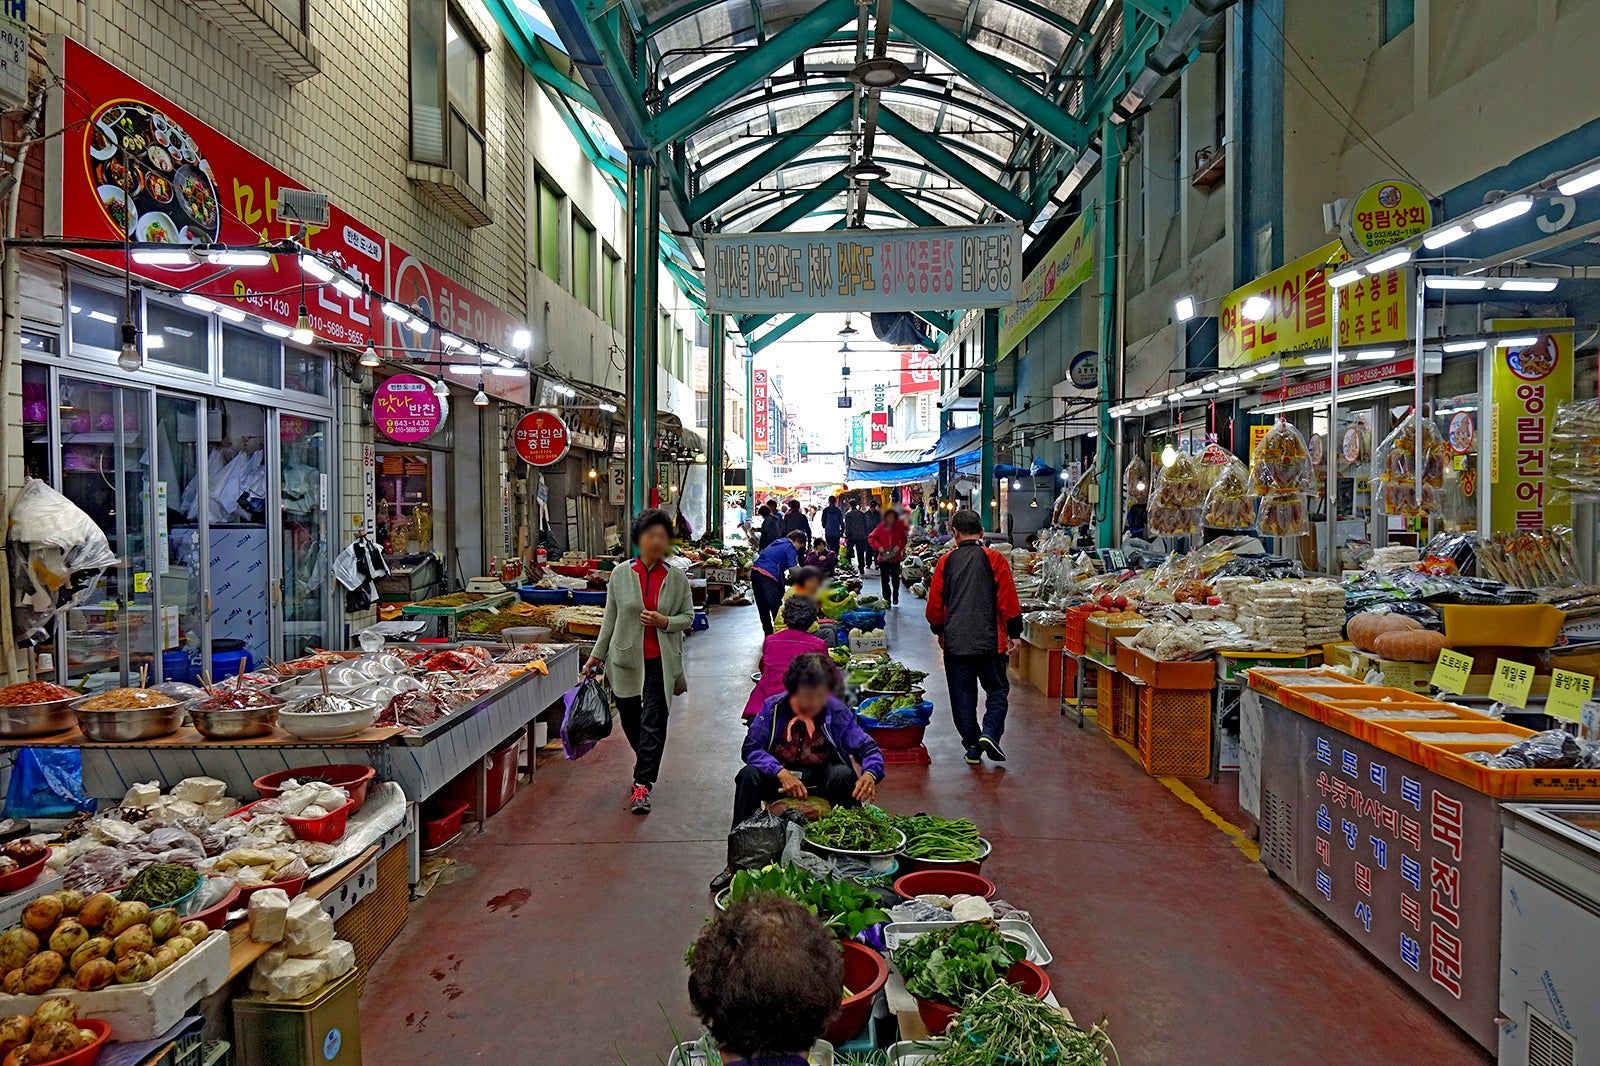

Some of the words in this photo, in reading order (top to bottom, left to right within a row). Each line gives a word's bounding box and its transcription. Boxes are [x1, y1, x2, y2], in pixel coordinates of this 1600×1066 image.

[1357, 206, 1425, 231] 영림상회
[246, 288, 290, 318] 643-1430
[378, 394, 413, 414] 맛나
[409, 403, 436, 417] 반찬
[755, 387, 766, 440] 제일가방
[517, 428, 564, 440] 한국인삼
[528, 439, 551, 450] 총판
[1440, 654, 1470, 675] 도토리묵
[1501, 665, 1528, 685] 메밀묵
[1554, 672, 1591, 695] 올방개묵
[1317, 736, 1421, 812] 도토리묵
[1316, 803, 1421, 891] 올방개묵
[1316, 835, 1420, 932] 메밀묵
[1430, 789, 1463, 1000] 묵전문
[1316, 868, 1420, 972] 묵사발
